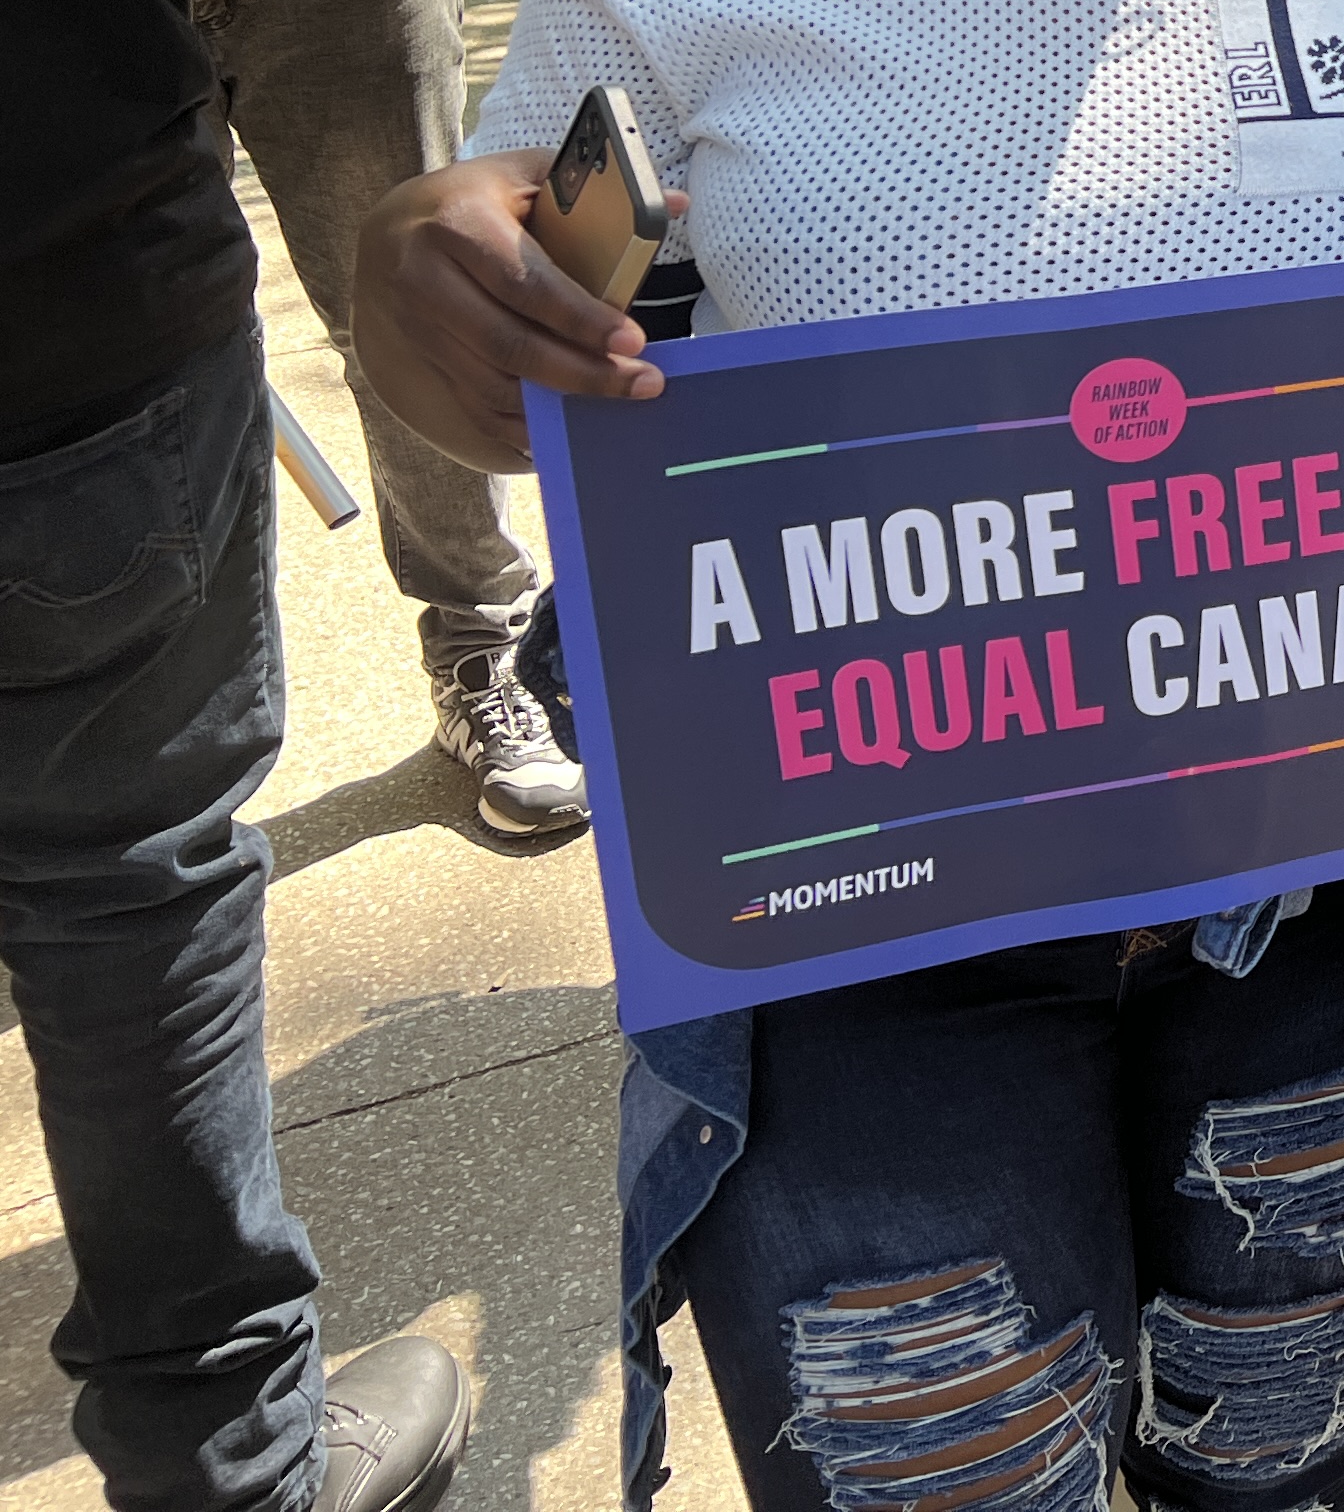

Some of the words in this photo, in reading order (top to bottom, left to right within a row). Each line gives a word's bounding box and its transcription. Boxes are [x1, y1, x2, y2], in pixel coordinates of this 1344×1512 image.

[1225, 41, 1282, 109] ERL
[1092, 377, 1162, 402] RAINBOW
[1109, 400, 1149, 421] WEEK
[1094, 426, 1113, 444] OF
[1115, 418, 1169, 442] ACTION
[690, 538, 761, 654] A
[781, 490, 1084, 633] MORE
[768, 629, 1104, 781] EQUAL
[768, 857, 934, 917] MOMENTUM
